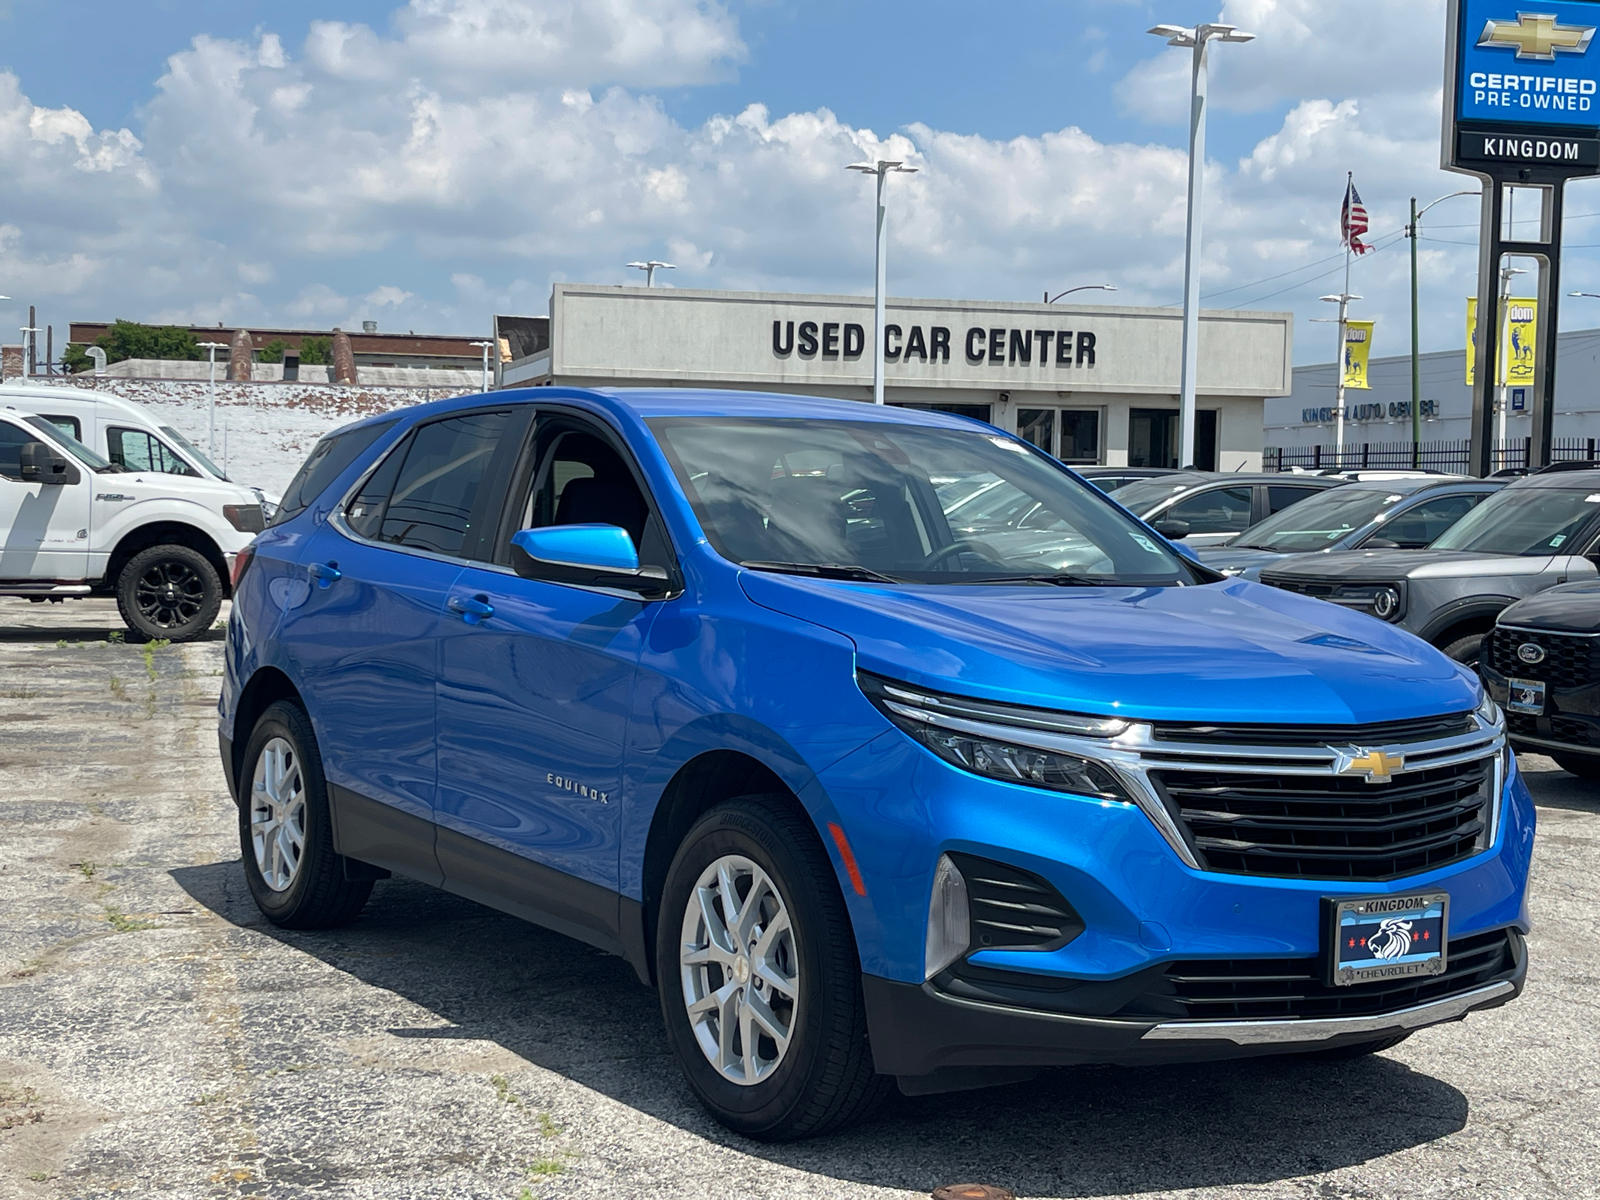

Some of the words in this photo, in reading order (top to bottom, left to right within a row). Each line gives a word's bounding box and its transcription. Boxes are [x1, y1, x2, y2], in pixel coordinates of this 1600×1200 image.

[1470, 72, 1597, 95] CERTIFIED
[1474, 90, 1591, 112] PRE-OWNED
[1484, 138, 1579, 160] KINGDOM
[1510, 304, 1534, 321] dom
[772, 320, 865, 356] USED
[884, 323, 951, 360] CAR
[965, 326, 1097, 365] CENTER
[1389, 399, 1438, 418] CENER
[546, 772, 608, 805] EQUINOX
[1365, 897, 1424, 913] KINGDOM
[1360, 964, 1420, 980] CHEVROLET
